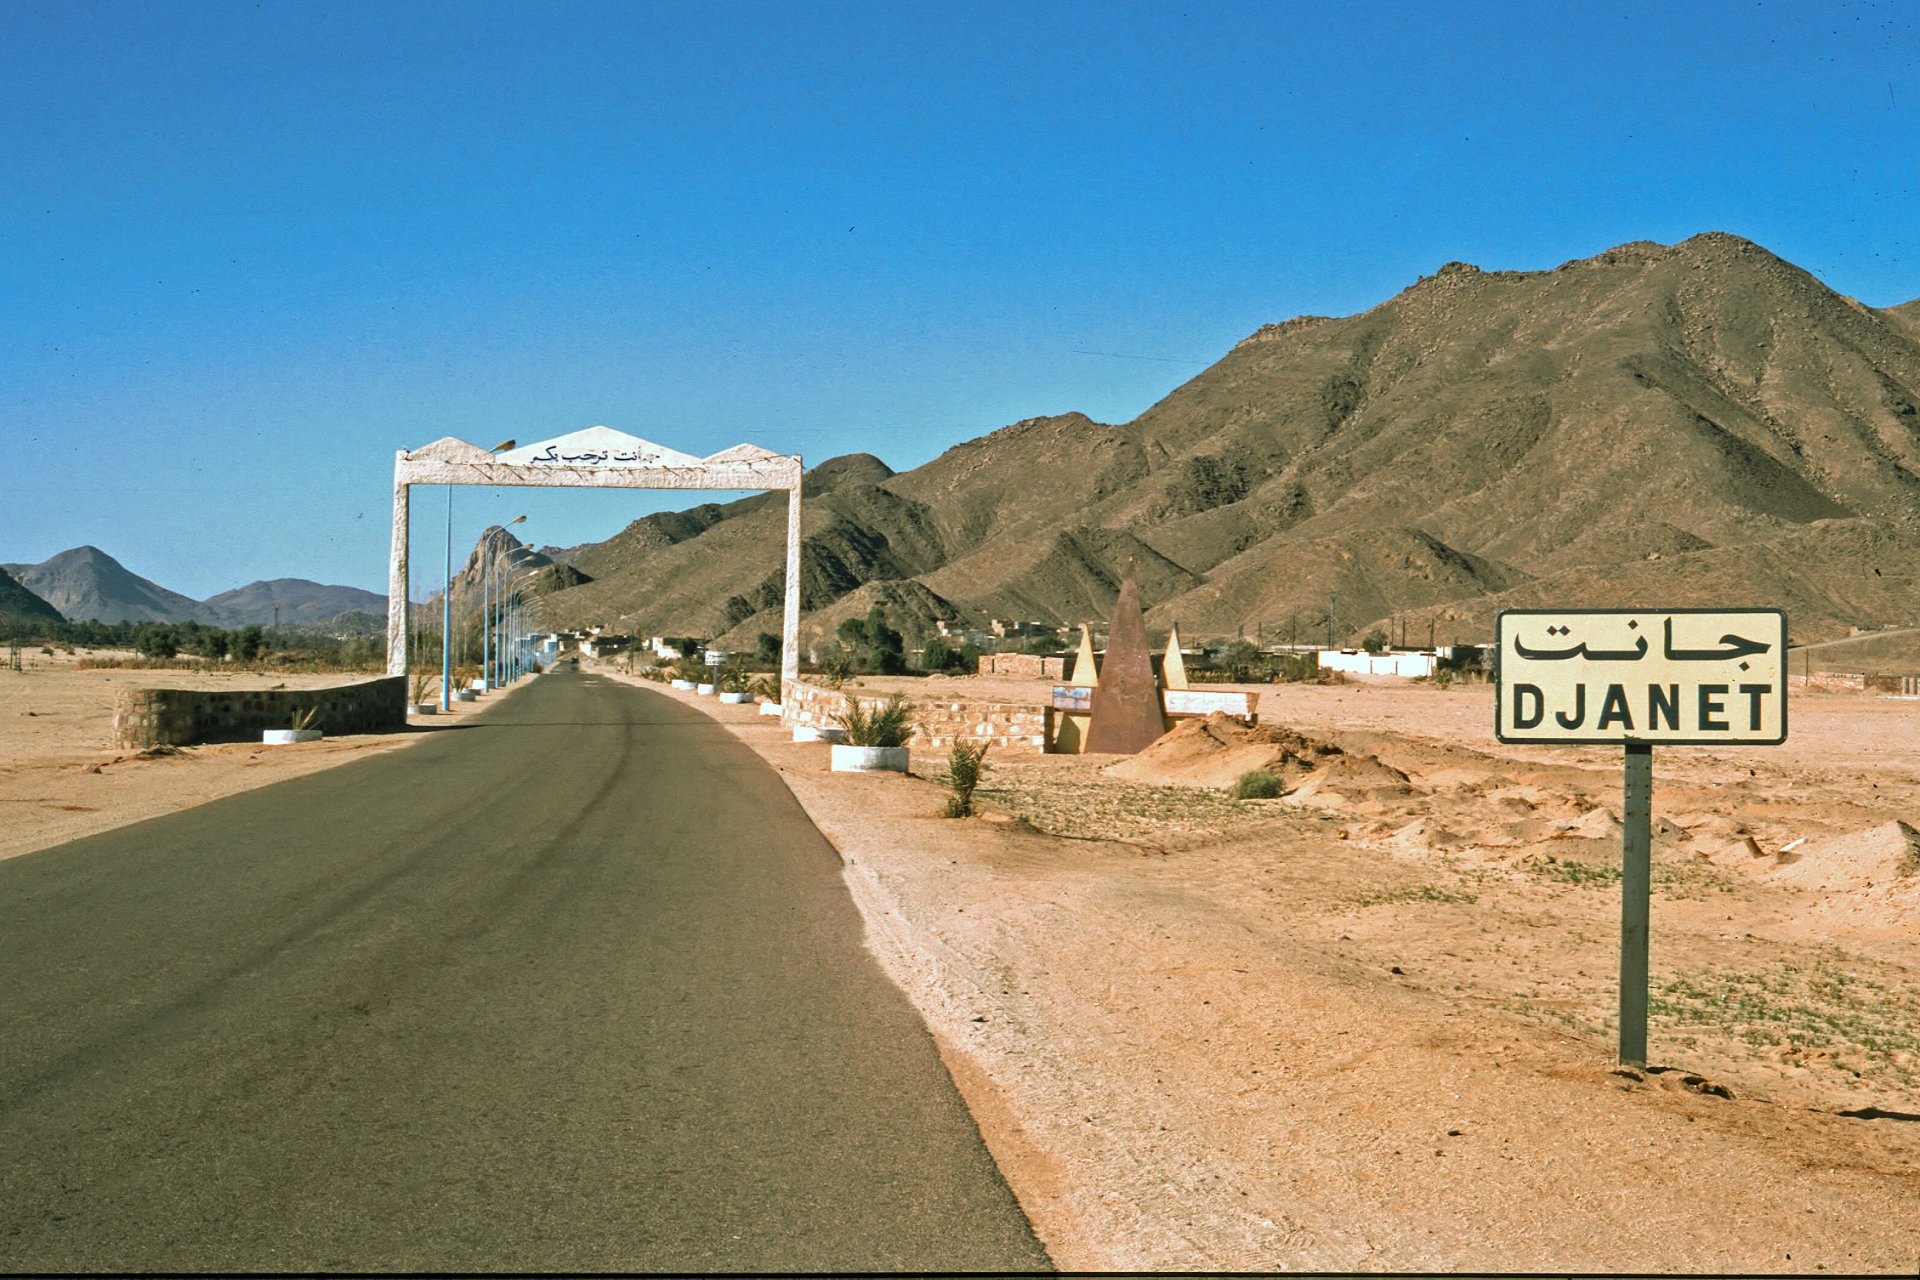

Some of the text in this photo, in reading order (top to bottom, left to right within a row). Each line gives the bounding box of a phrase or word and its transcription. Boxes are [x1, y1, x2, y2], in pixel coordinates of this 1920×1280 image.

[530, 446, 558, 464] بكم
[561, 450, 609, 465] ترحب
[1514, 616, 1772, 672] جانت
[1513, 683, 1772, 731] DJANET
